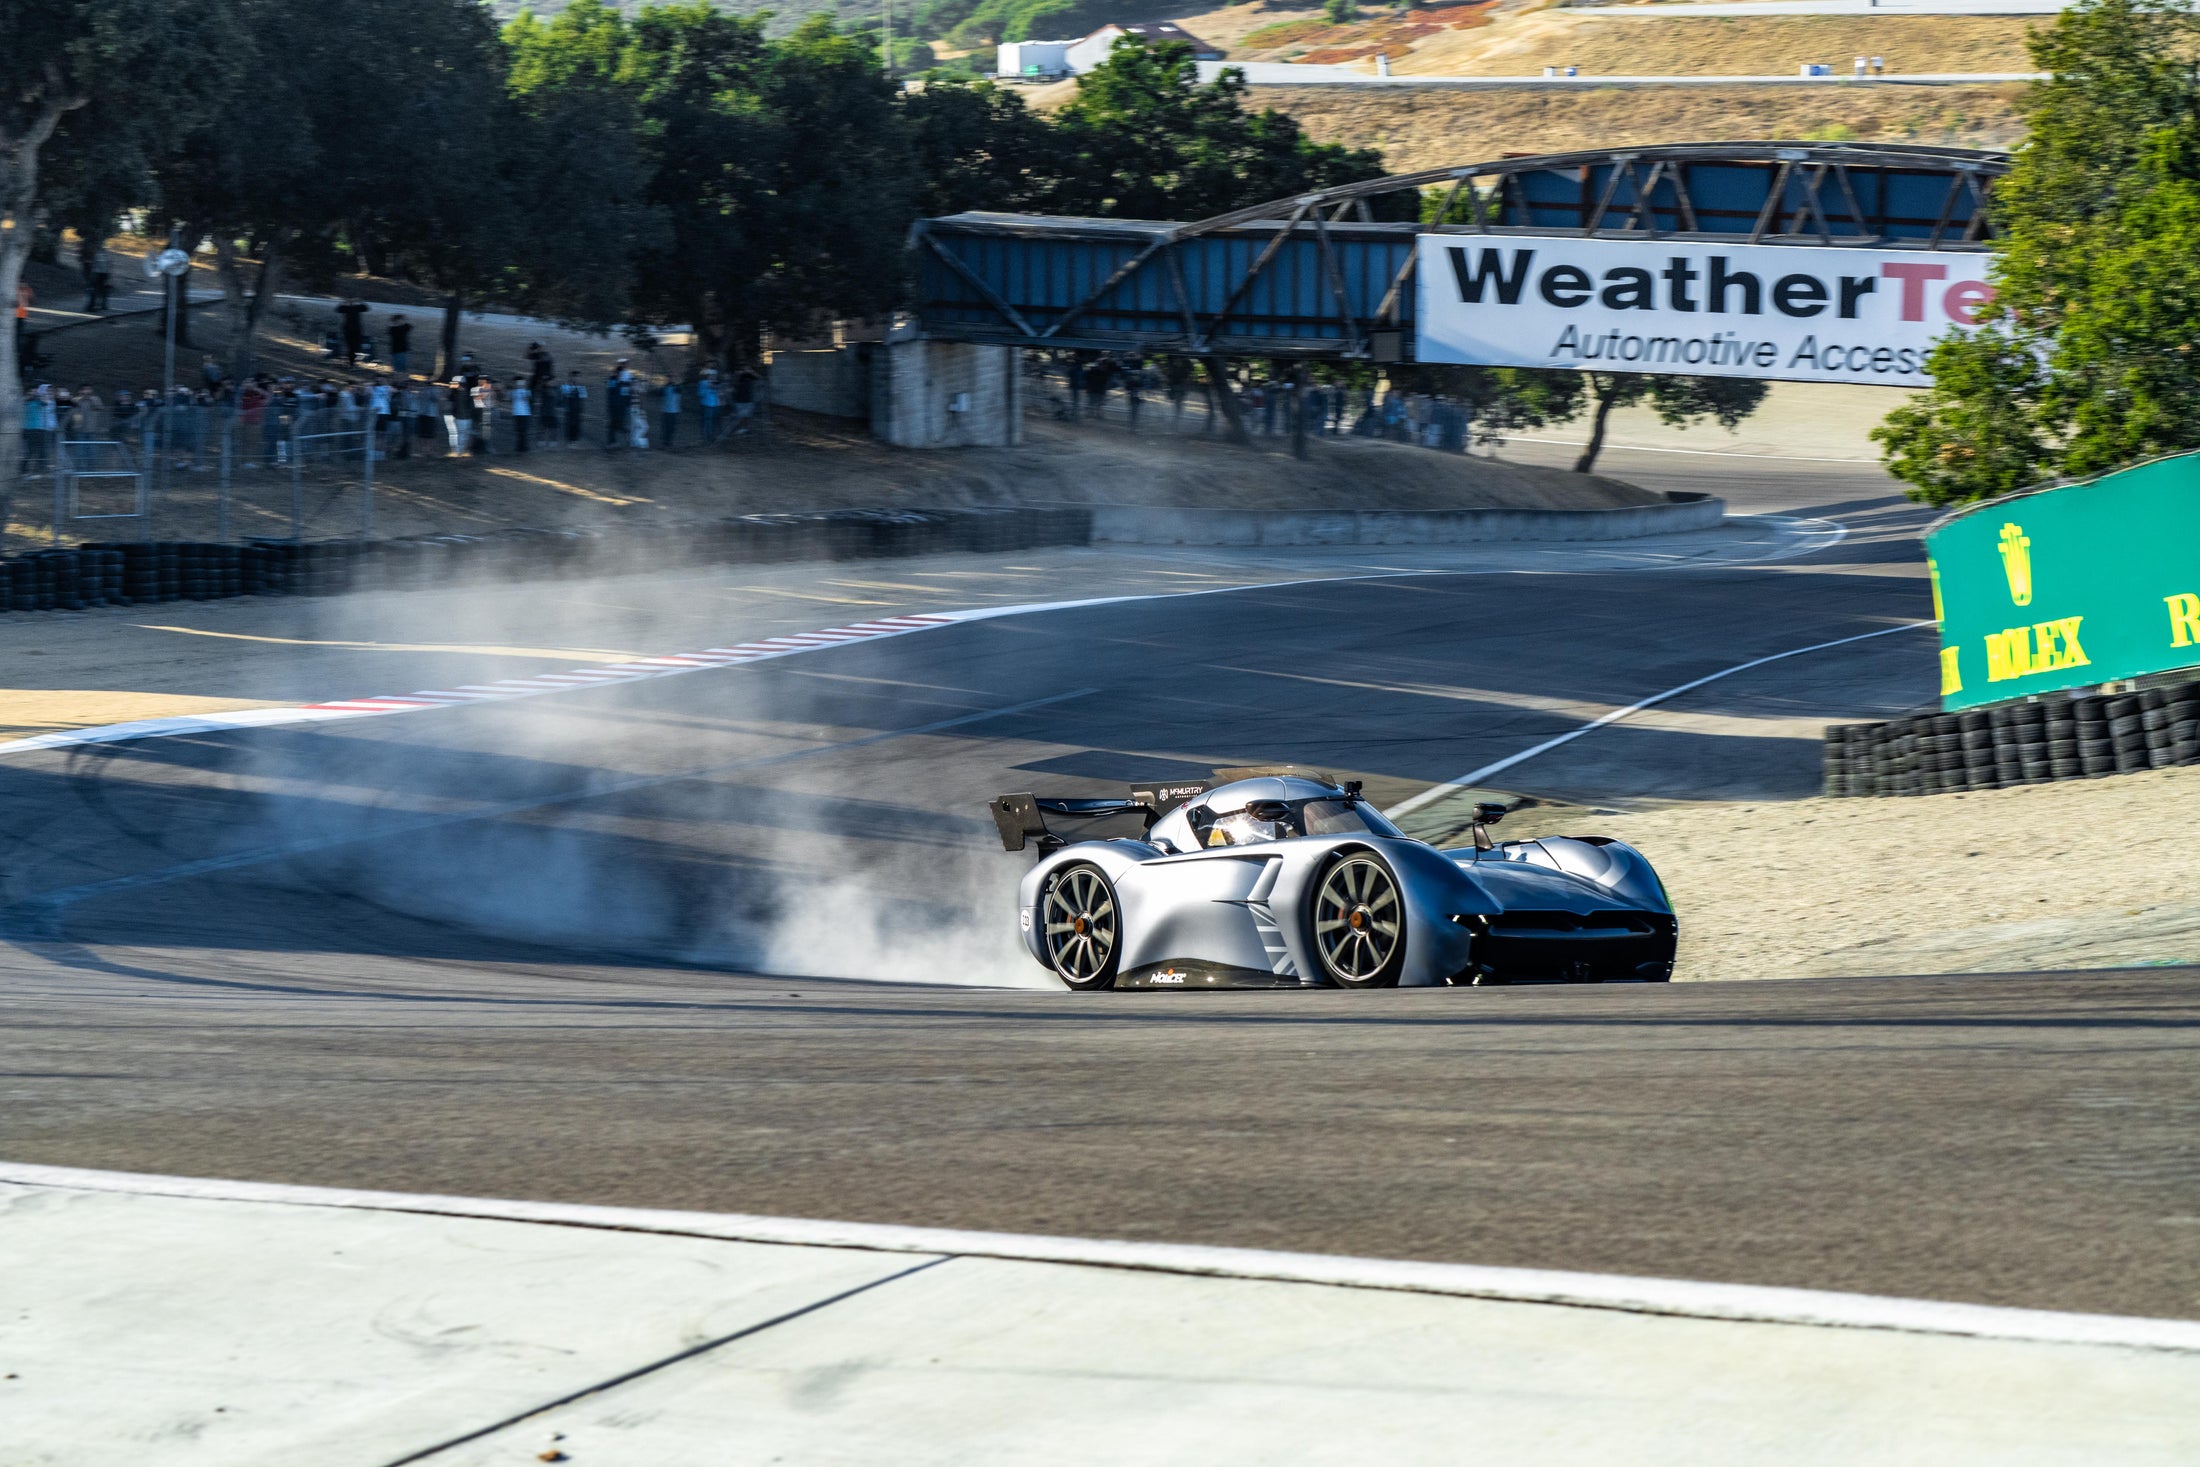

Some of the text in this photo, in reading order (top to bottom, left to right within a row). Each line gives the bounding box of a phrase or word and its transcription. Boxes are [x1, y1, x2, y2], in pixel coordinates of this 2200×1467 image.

[1446, 246, 2000, 325] WeatherTe
[1550, 324, 1935, 376] Automotive Access
